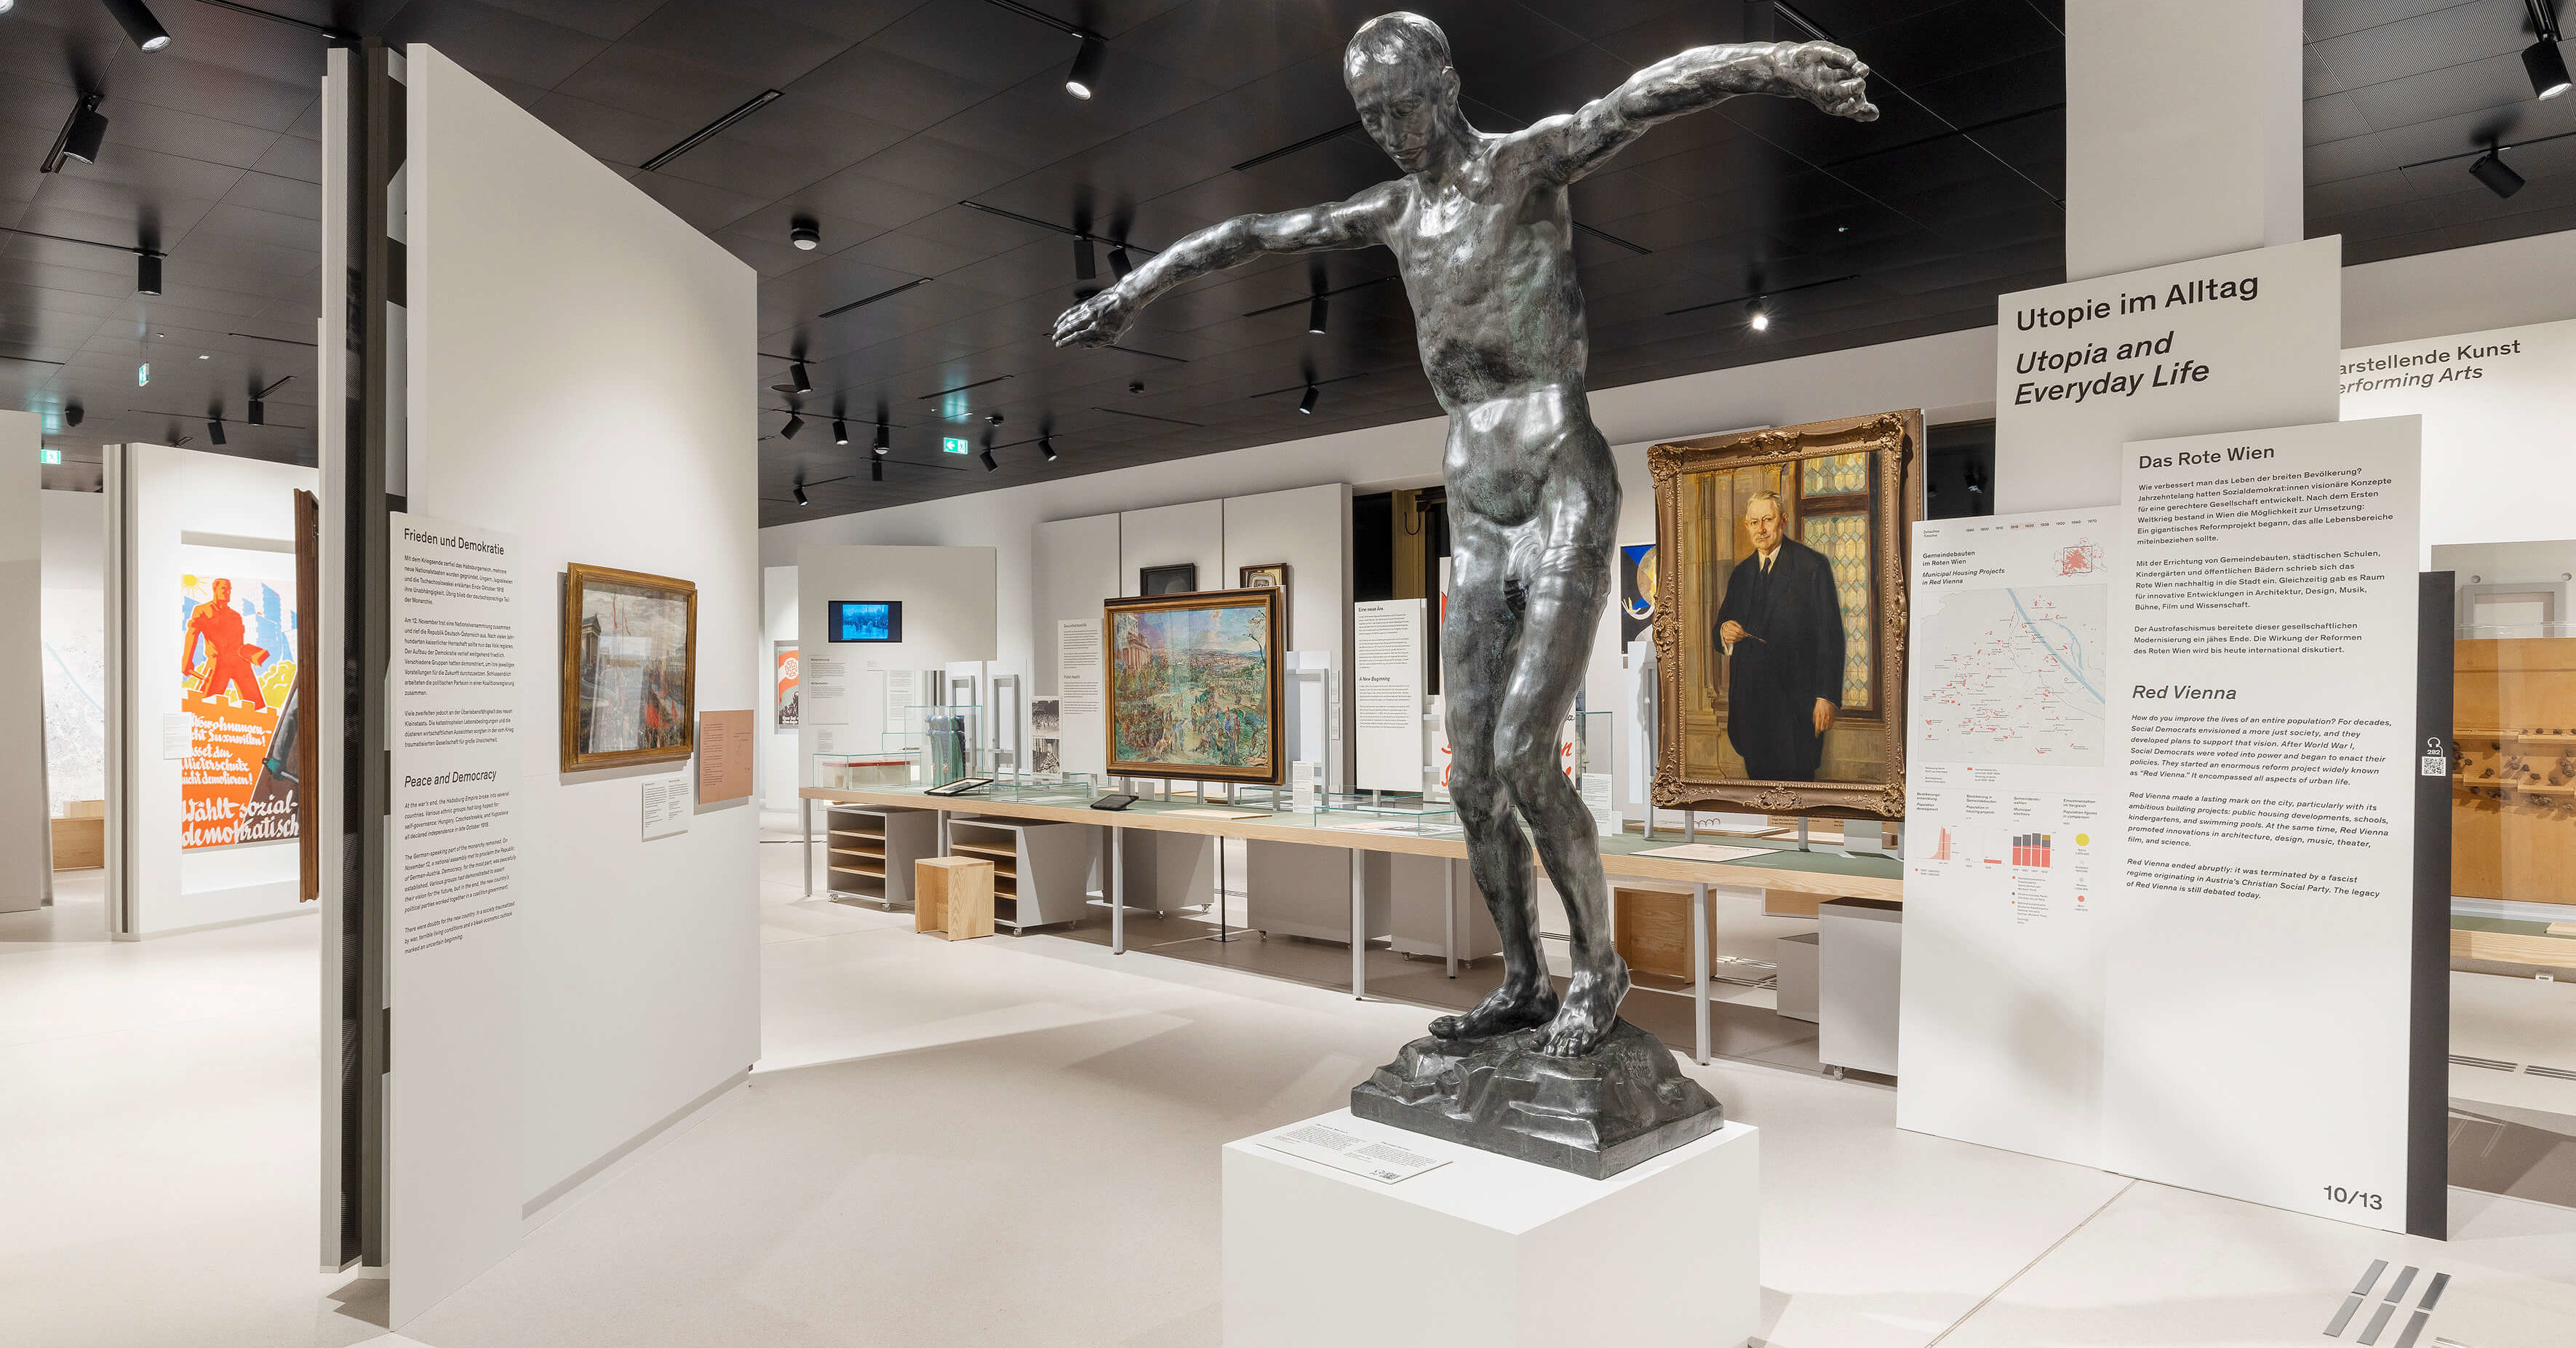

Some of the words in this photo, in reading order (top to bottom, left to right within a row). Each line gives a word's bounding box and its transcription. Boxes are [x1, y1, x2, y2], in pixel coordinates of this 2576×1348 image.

[2018, 299, 2110, 331] Utopie
[2121, 293, 2156, 315] im
[2165, 277, 2257, 308] Alltag
[2017, 343, 2108, 374] Utopia
[2116, 330, 2174, 360] and
[2340, 350, 2450, 375] arstellende
[2458, 340, 2520, 360] Kunst
[2014, 372, 2145, 405] Everyday
[2153, 360, 2209, 387] Life
[2340, 372, 2434, 394] erforming
[2439, 366, 2483, 383] Arts
[2140, 456, 2172, 468] Das
[2179, 450, 2221, 466] Rote
[2227, 447, 2274, 461] Wien
[2154, 481, 2194, 489] verbessert
[2305, 468, 2361, 478] Bevölkerung?
[2139, 493, 2193, 501] Jahrzehntelang
[2223, 485, 2309, 495] Sozialdemokrat:innen
[2167, 503, 2208, 511] gerechtere
[2209, 498, 2258, 507] Gesellschaft
[2260, 496, 2304, 504] entwickelt.
[2251, 508, 2297, 517] Möglichkeit
[2150, 526, 2198, 535] gigantisches
[2200, 522, 2256, 530] Reformprojekt
[2326, 514, 2393, 523] Lebensbereiche
[404, 528, 437, 545] Frieden
[440, 536, 455, 547] und
[458, 537, 504, 555] Demokratie
[2137, 537, 2193, 545] miteinbeziehen
[1923, 551, 1975, 559] Gemeindebauten
[2132, 685, 2169, 698] Red
[2174, 685, 2236, 700] Vienna
[2353, 719, 2391, 727] decades,
[2289, 730, 2321, 738] society,
[212, 746, 233, 759] den
[404, 775, 432, 788] Peace
[434, 772, 450, 785] and
[452, 771, 496, 783] Democracy
[182, 797, 241, 823] Wählt
[239, 790, 298, 818] sozial-
[182, 813, 300, 847] demokratisch
[2153, 883, 2177, 891] Vienna
[2204, 888, 2236, 896] debated
[2238, 890, 2261, 900] today.
[2324, 1185, 2382, 1210] 10/13
